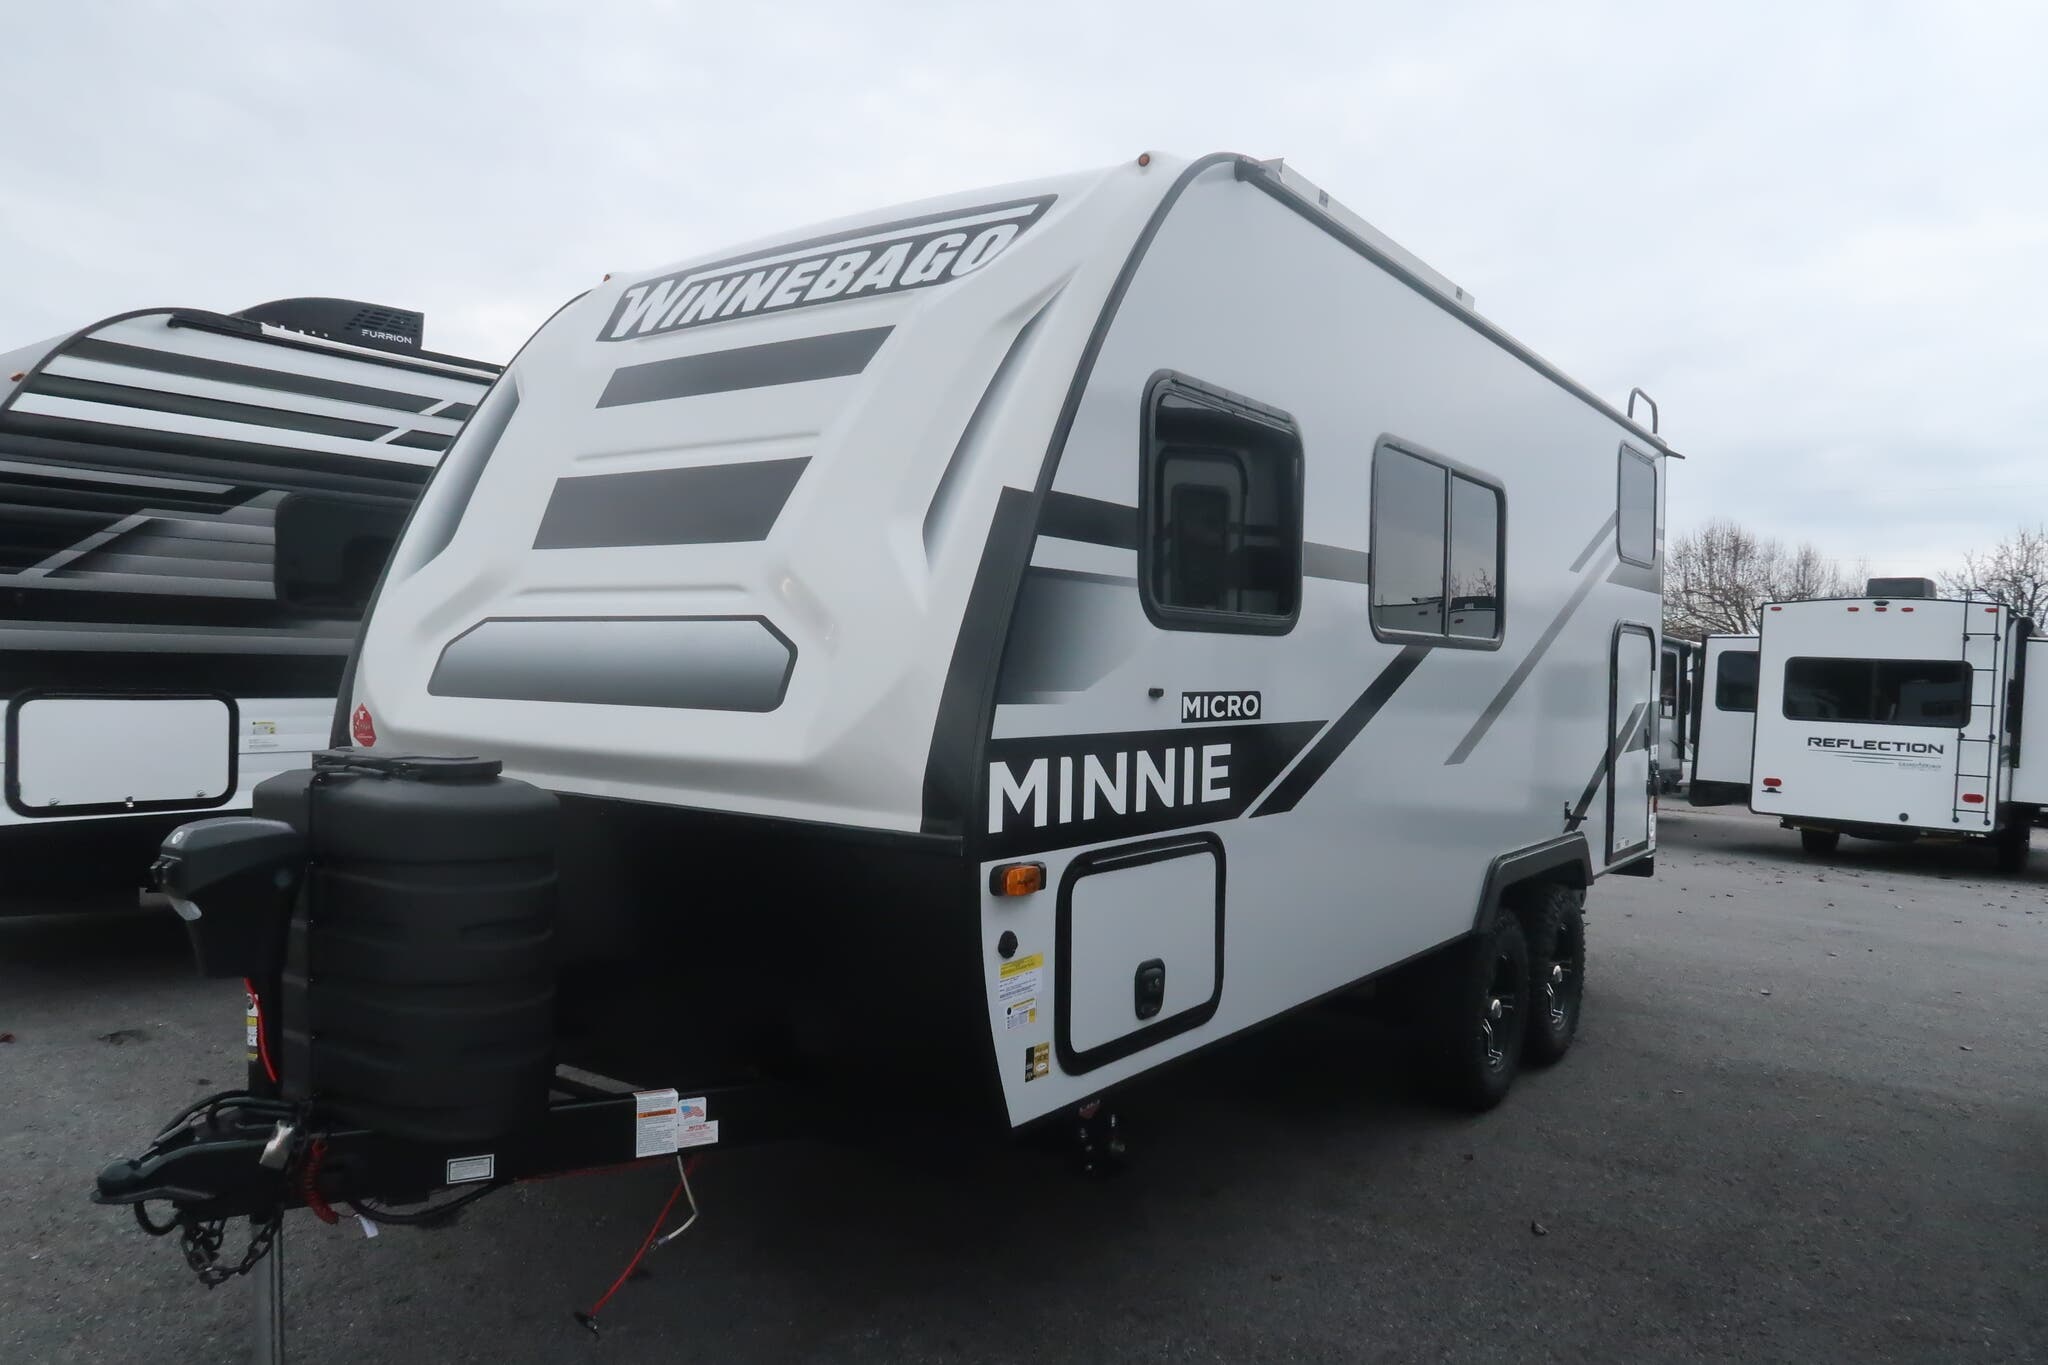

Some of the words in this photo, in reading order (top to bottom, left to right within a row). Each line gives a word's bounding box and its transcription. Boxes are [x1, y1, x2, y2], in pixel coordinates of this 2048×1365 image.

[610, 223, 1019, 338] WINNEBAGO
[361, 328, 413, 345] FURRION
[1182, 694, 1259, 719] MICRO
[1807, 737, 1944, 754] REFLECTION
[988, 743, 1231, 834] MINNIE
